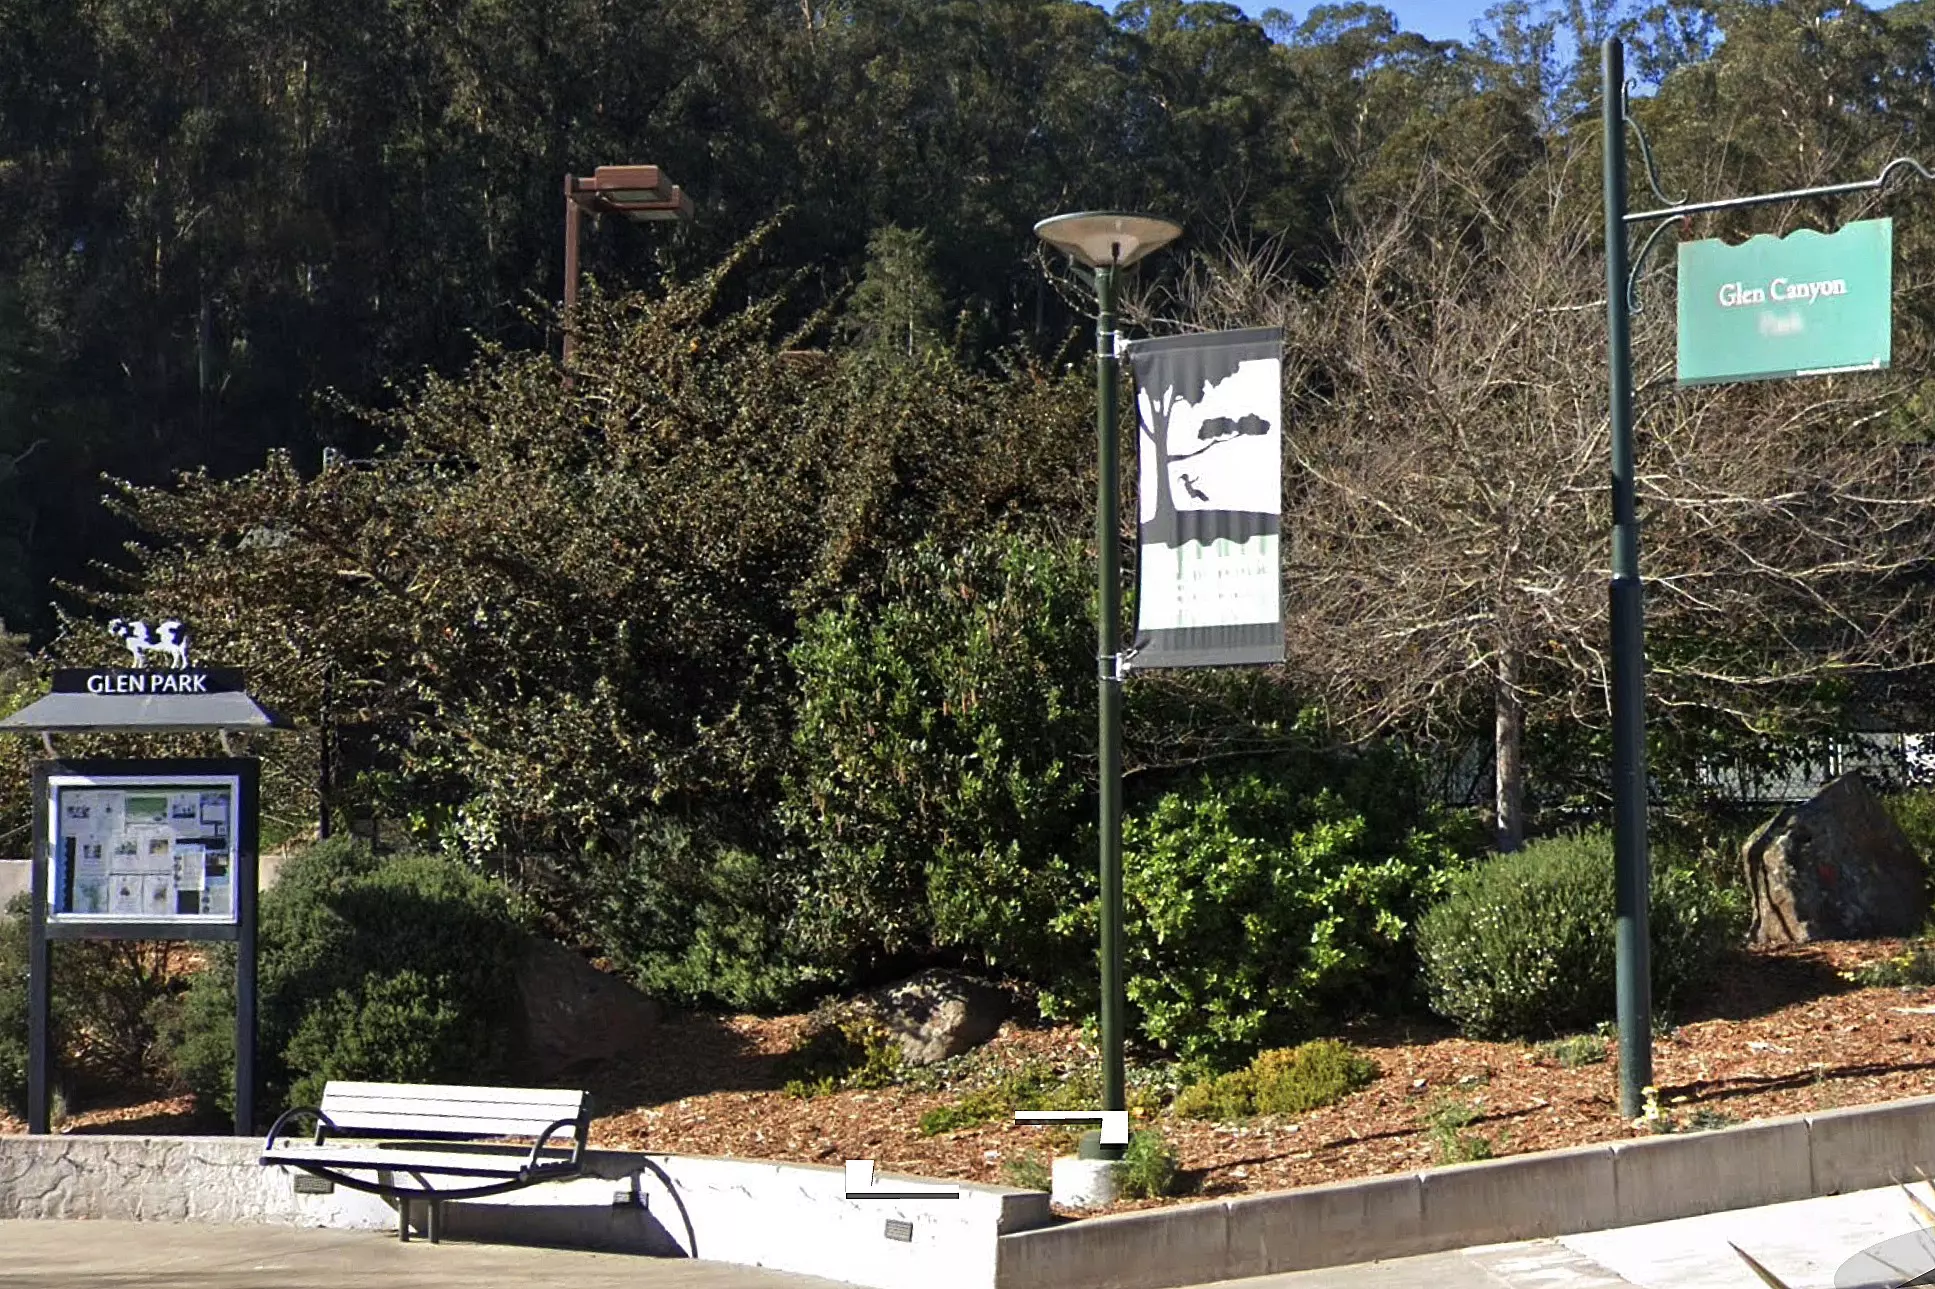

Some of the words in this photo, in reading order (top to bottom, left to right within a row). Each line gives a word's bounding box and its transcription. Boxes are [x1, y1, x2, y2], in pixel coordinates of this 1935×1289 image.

[1719, 282, 1766, 306] Glen
[1770, 278, 1847, 305] Canyon
[87, 674, 145, 693] GLEN
[151, 674, 207, 692] PARK
